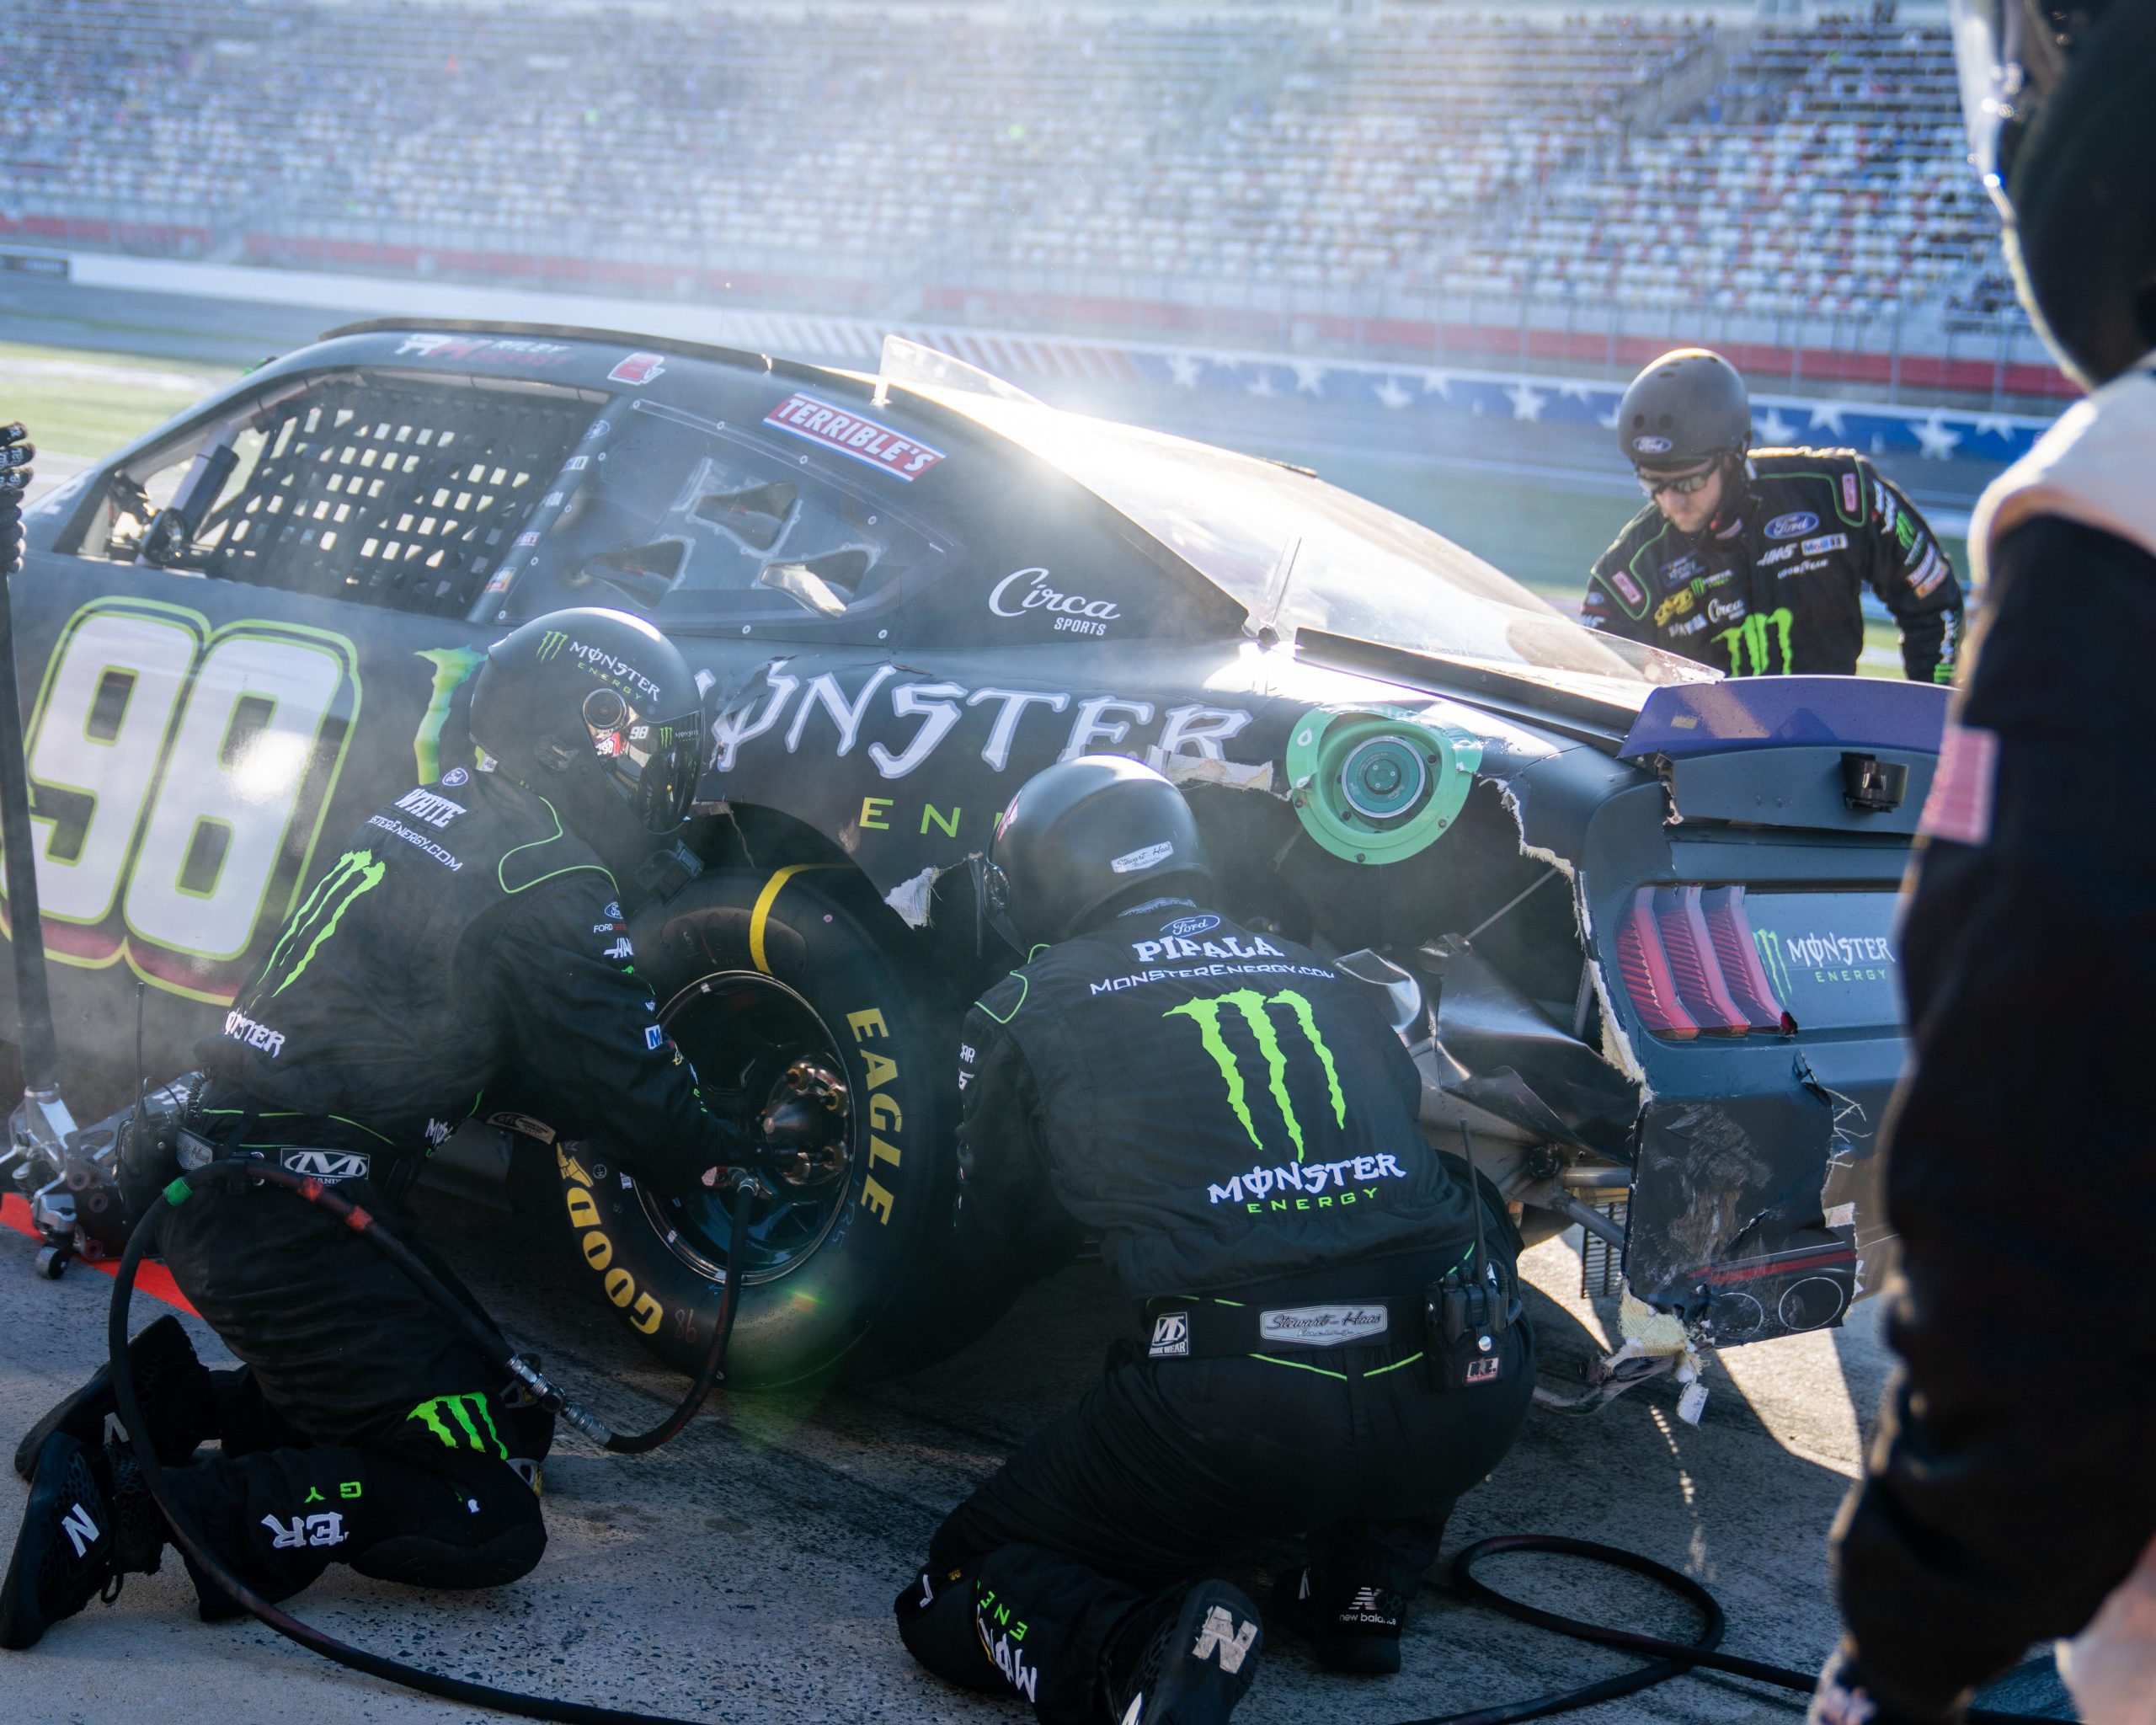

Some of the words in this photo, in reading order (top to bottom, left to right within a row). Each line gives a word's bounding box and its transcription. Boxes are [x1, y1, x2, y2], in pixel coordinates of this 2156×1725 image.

[777, 398, 935, 472] TERRIBLE'S
[1773, 515, 1810, 537] Ford
[989, 567, 1122, 617] Circa
[1054, 617, 1107, 637] SPORTS
[568, 641, 661, 702] MONSTER
[577, 661, 643, 701] ENERGY
[628, 725, 649, 740] 98
[0, 602, 354, 981] 98
[394, 788, 467, 828] WHITE
[593, 923, 613, 932] FORD
[1171, 917, 1209, 937] Ford
[1132, 936, 1285, 962] PIPALA
[1786, 931, 1896, 968] MONSTER
[1816, 968, 1886, 984] ENERGY
[846, 1007, 903, 1226] EAGLE
[1207, 1153, 1407, 1204] MONSTER
[1246, 1188, 1378, 1213] ENERGY
[566, 1187, 664, 1335] GOOD
